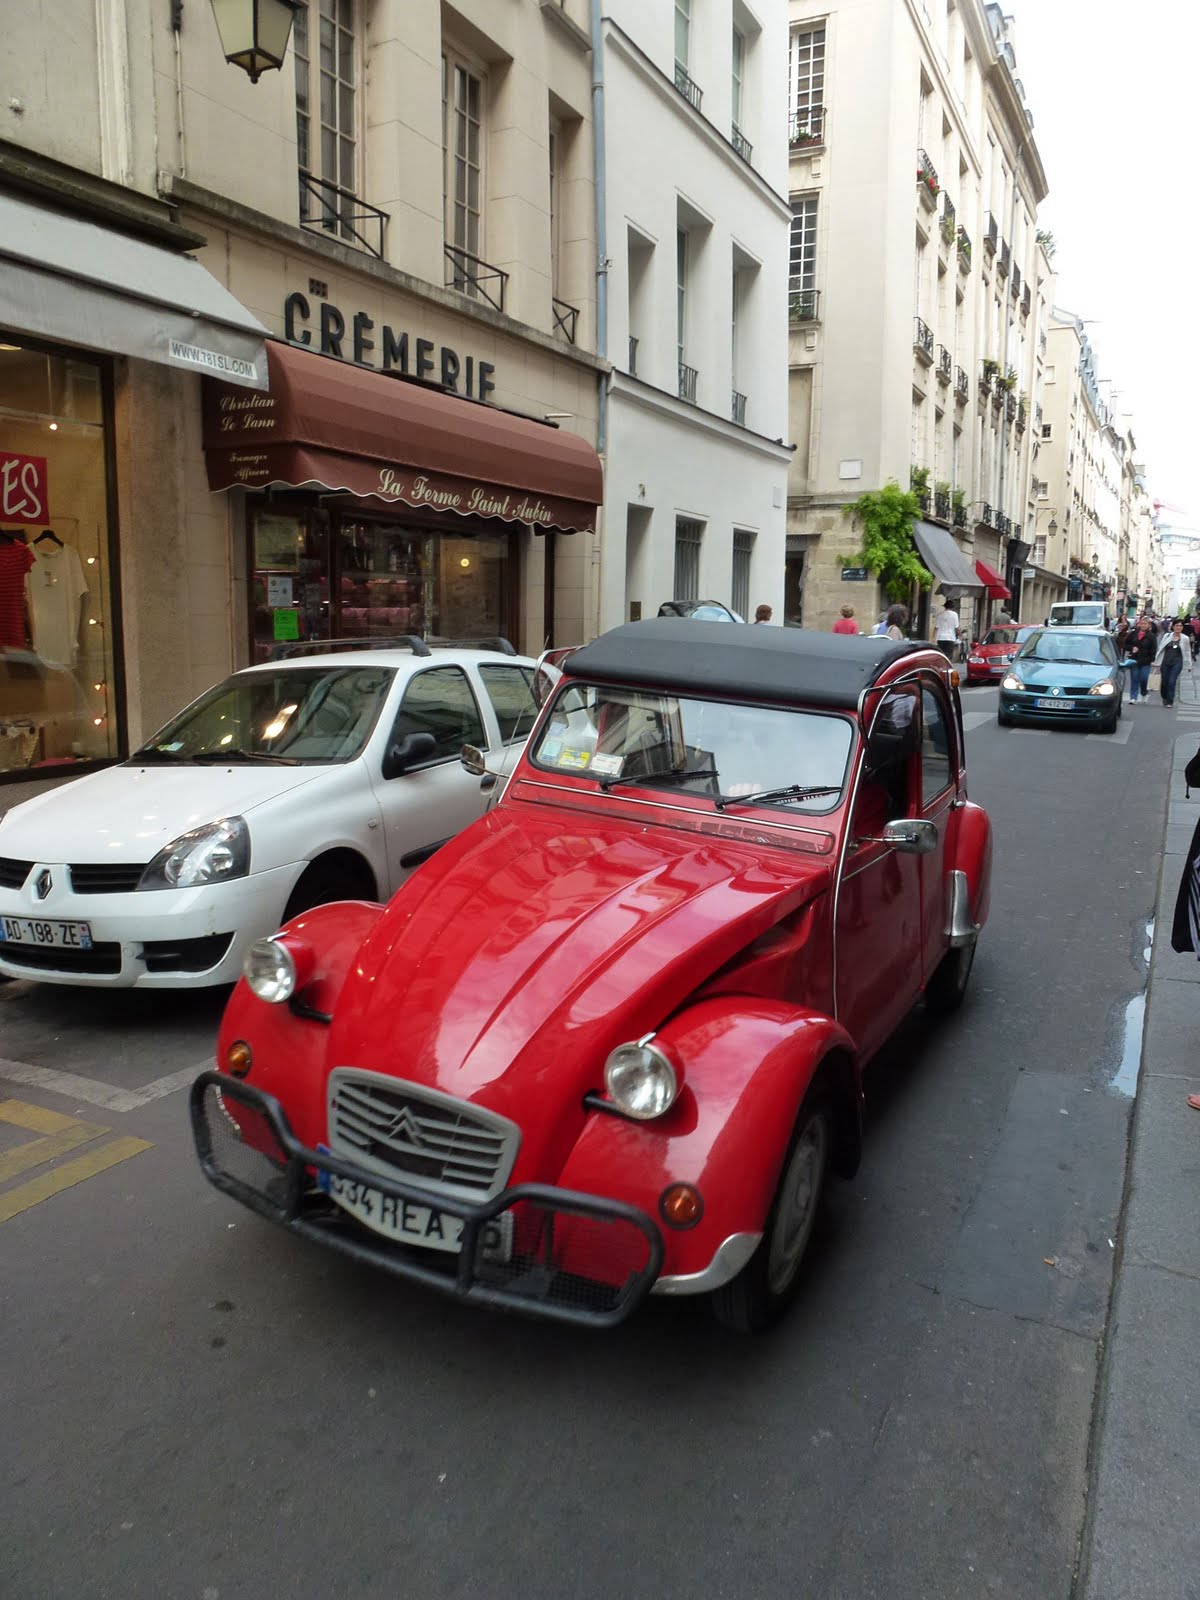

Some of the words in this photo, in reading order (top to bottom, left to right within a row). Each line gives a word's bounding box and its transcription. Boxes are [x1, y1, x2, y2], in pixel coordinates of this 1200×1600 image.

[220, 394, 277, 411] Christian
[221, 416, 236, 431] Le
[241, 414, 276, 429] Lann
[377, 468, 404, 496] La
[411, 476, 462, 507] Ferme
[467, 487, 510, 515] Saint
[512, 497, 554, 522] Aubin
